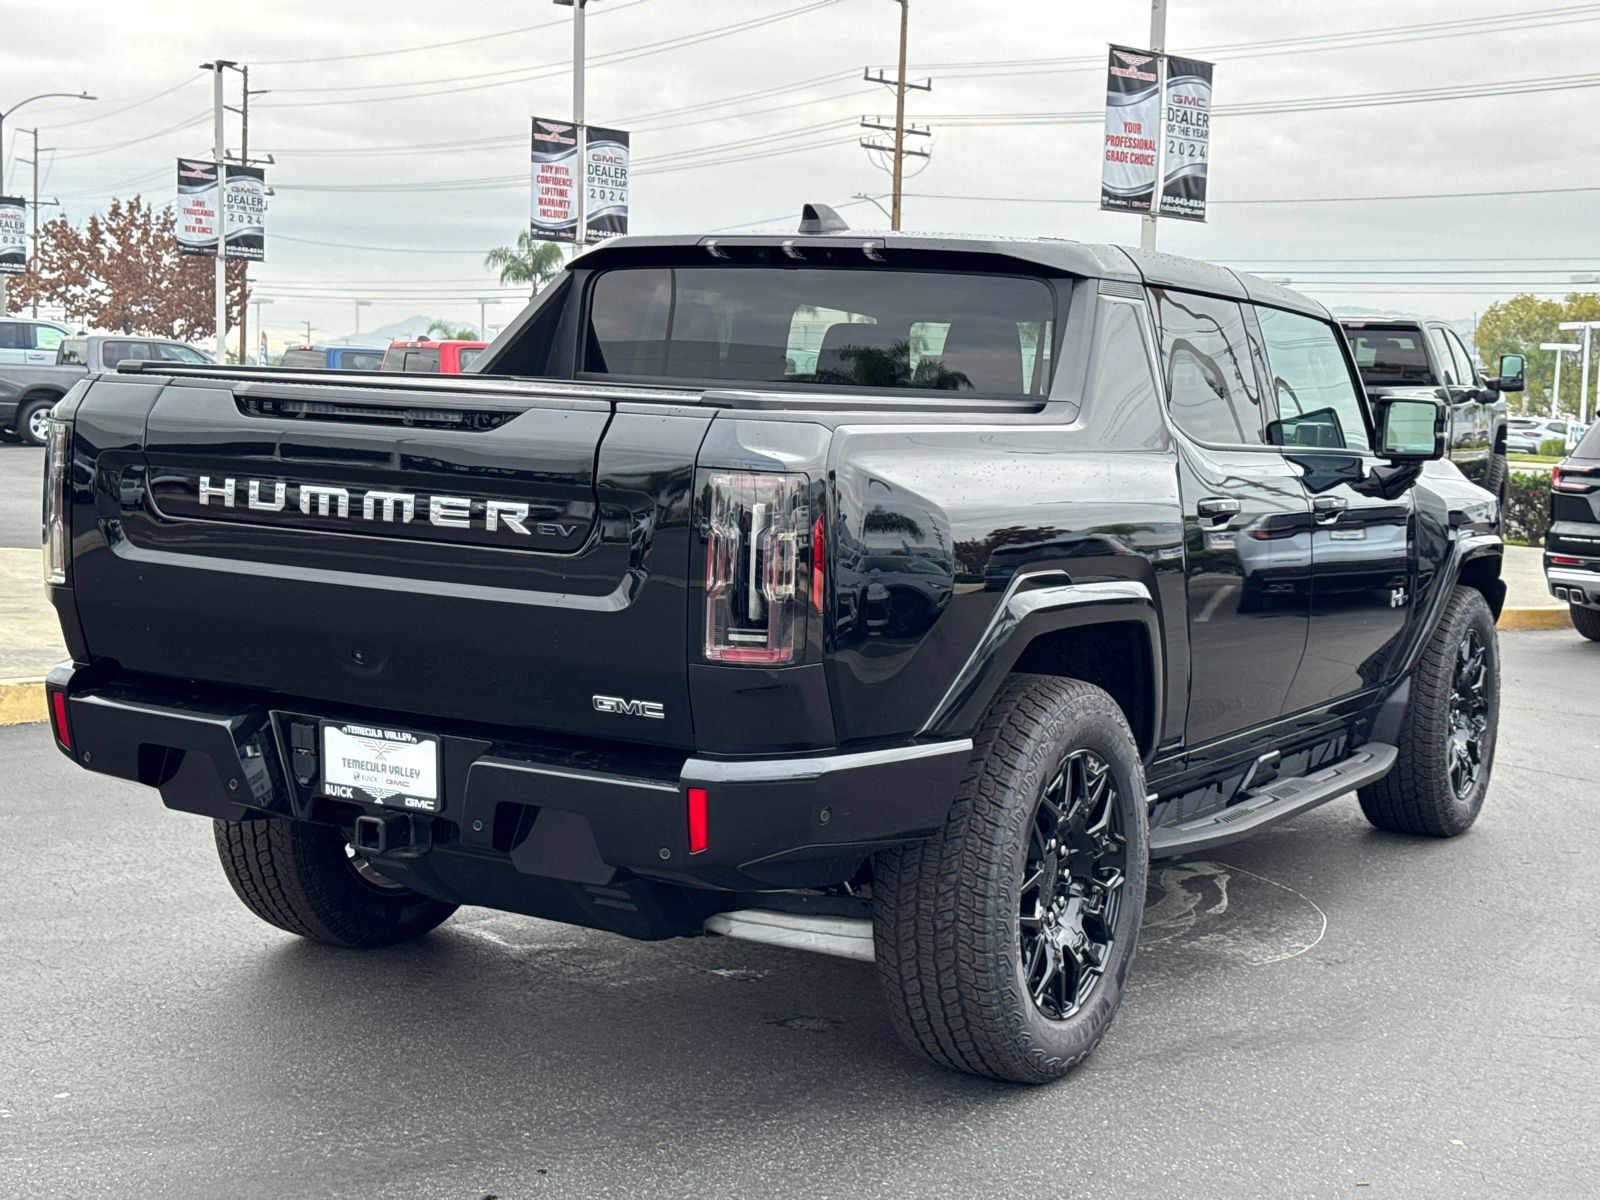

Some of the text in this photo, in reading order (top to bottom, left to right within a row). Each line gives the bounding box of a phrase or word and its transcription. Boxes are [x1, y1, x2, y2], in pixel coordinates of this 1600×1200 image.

[1172, 94, 1206, 108] GMC
[1168, 108, 1209, 128] DEALER
[1124, 122, 1142, 134] YOUR
[1168, 124, 1209, 139] OF THE YEAR
[1106, 135, 1156, 151] PROFESSIONAL
[1169, 140, 1205, 158] 2024
[592, 154, 624, 164] GMC
[1106, 150, 1154, 166] GRADE CHOICE
[541, 164, 569, 176] BUY WITH
[588, 164, 627, 180] DEALER
[536, 175, 573, 187] CONFIDENCE
[598, 177, 610, 186] THE
[611, 179, 627, 188] YEAR
[231, 186, 260, 194] GMC
[542, 186, 568, 198] LIFETIME
[590, 188, 625, 202] 2024
[227, 194, 263, 207] DEALER
[538, 197, 571, 208] WARRANTY
[183, 208, 214, 217] THOUSANDS
[230, 214, 262, 224] 2024
[540, 208, 568, 220] INCLUDED
[0, 220, 25, 229] EALER
[200, 476, 578, 538] HUMMER EV
[592, 695, 665, 718] GMC
[346, 725, 412, 741] TEMECULA VALLEY
[342, 758, 420, 779] TEMECULA VALLEY
[362, 774, 410, 788] BUICK GMC
[325, 784, 434, 810] BUICK GMC
